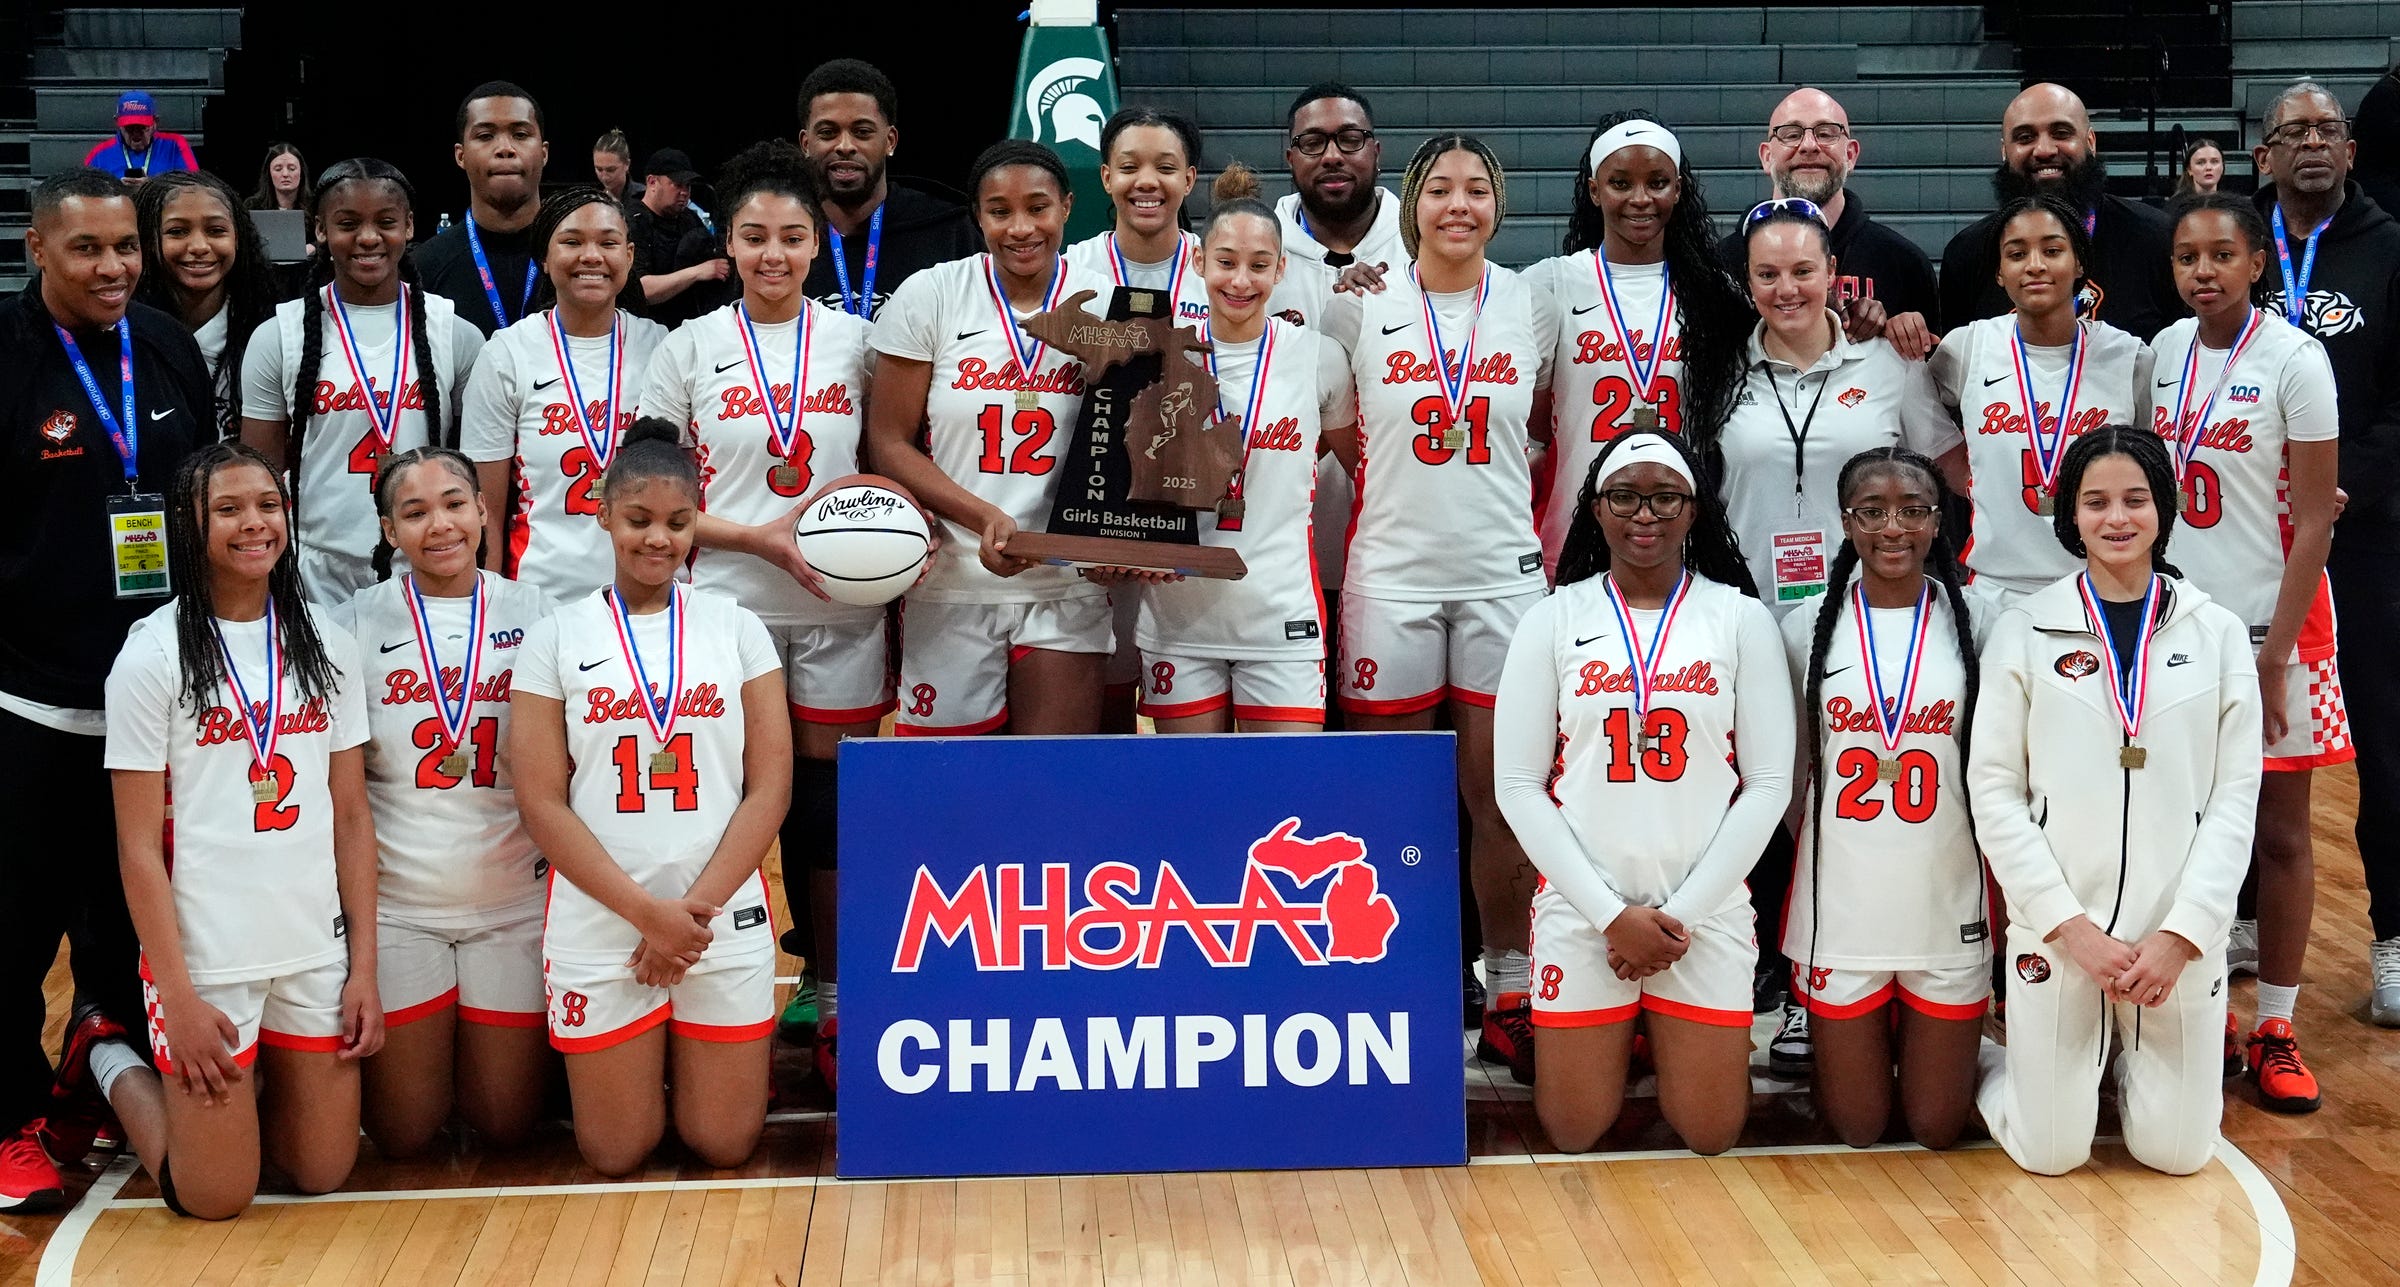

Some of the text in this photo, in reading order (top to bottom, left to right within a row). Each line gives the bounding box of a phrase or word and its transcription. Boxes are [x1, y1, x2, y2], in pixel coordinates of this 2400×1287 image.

[833, 247, 849, 303] CHAMPIONSHIPS
[2299, 236, 2316, 288] CHAMPIONSHIPS
[861, 280, 872, 319] CHAMPION
[2284, 268, 2297, 316] CHAMPIONSHIPS
[1068, 325, 1142, 350] MHSAA
[75, 359, 111, 421] CHAMPIONSHIPS
[1590, 375, 1684, 443] 23
[2230, 385, 2261, 401] 100
[977, 403, 1057, 476] 12
[1086, 388, 1114, 502] CHAMPION
[1411, 395, 1492, 466] 31
[40, 446, 86, 460] Basketball
[766, 427, 816, 498] 3
[1162, 476, 1197, 490] 2025
[2180, 460, 2224, 530] 0
[126, 518, 153, 528] BENCH
[817, 489, 906, 522] Rawlings
[1062, 508, 1186, 531] Girls Basketball
[1099, 528, 1139, 539] DIVISION
[1795, 535, 1816, 543] MEDICAL
[490, 628, 525, 647] 100
[1309, 625, 1316, 633] M
[1150, 660, 1176, 695] B
[1351, 657, 1379, 691] B
[2171, 653, 2189, 663] NIKE
[907, 682, 937, 718] B
[411, 716, 499, 790] 21
[1603, 707, 1691, 782] 13
[248, 752, 298, 832] 2
[612, 732, 699, 813] 14
[1836, 746, 1941, 824] 20
[891, 860, 1330, 973] MHSAA
[1537, 964, 1564, 1001] B
[562, 990, 589, 1027] B
[877, 1012, 1411, 1094] CHAMPION
